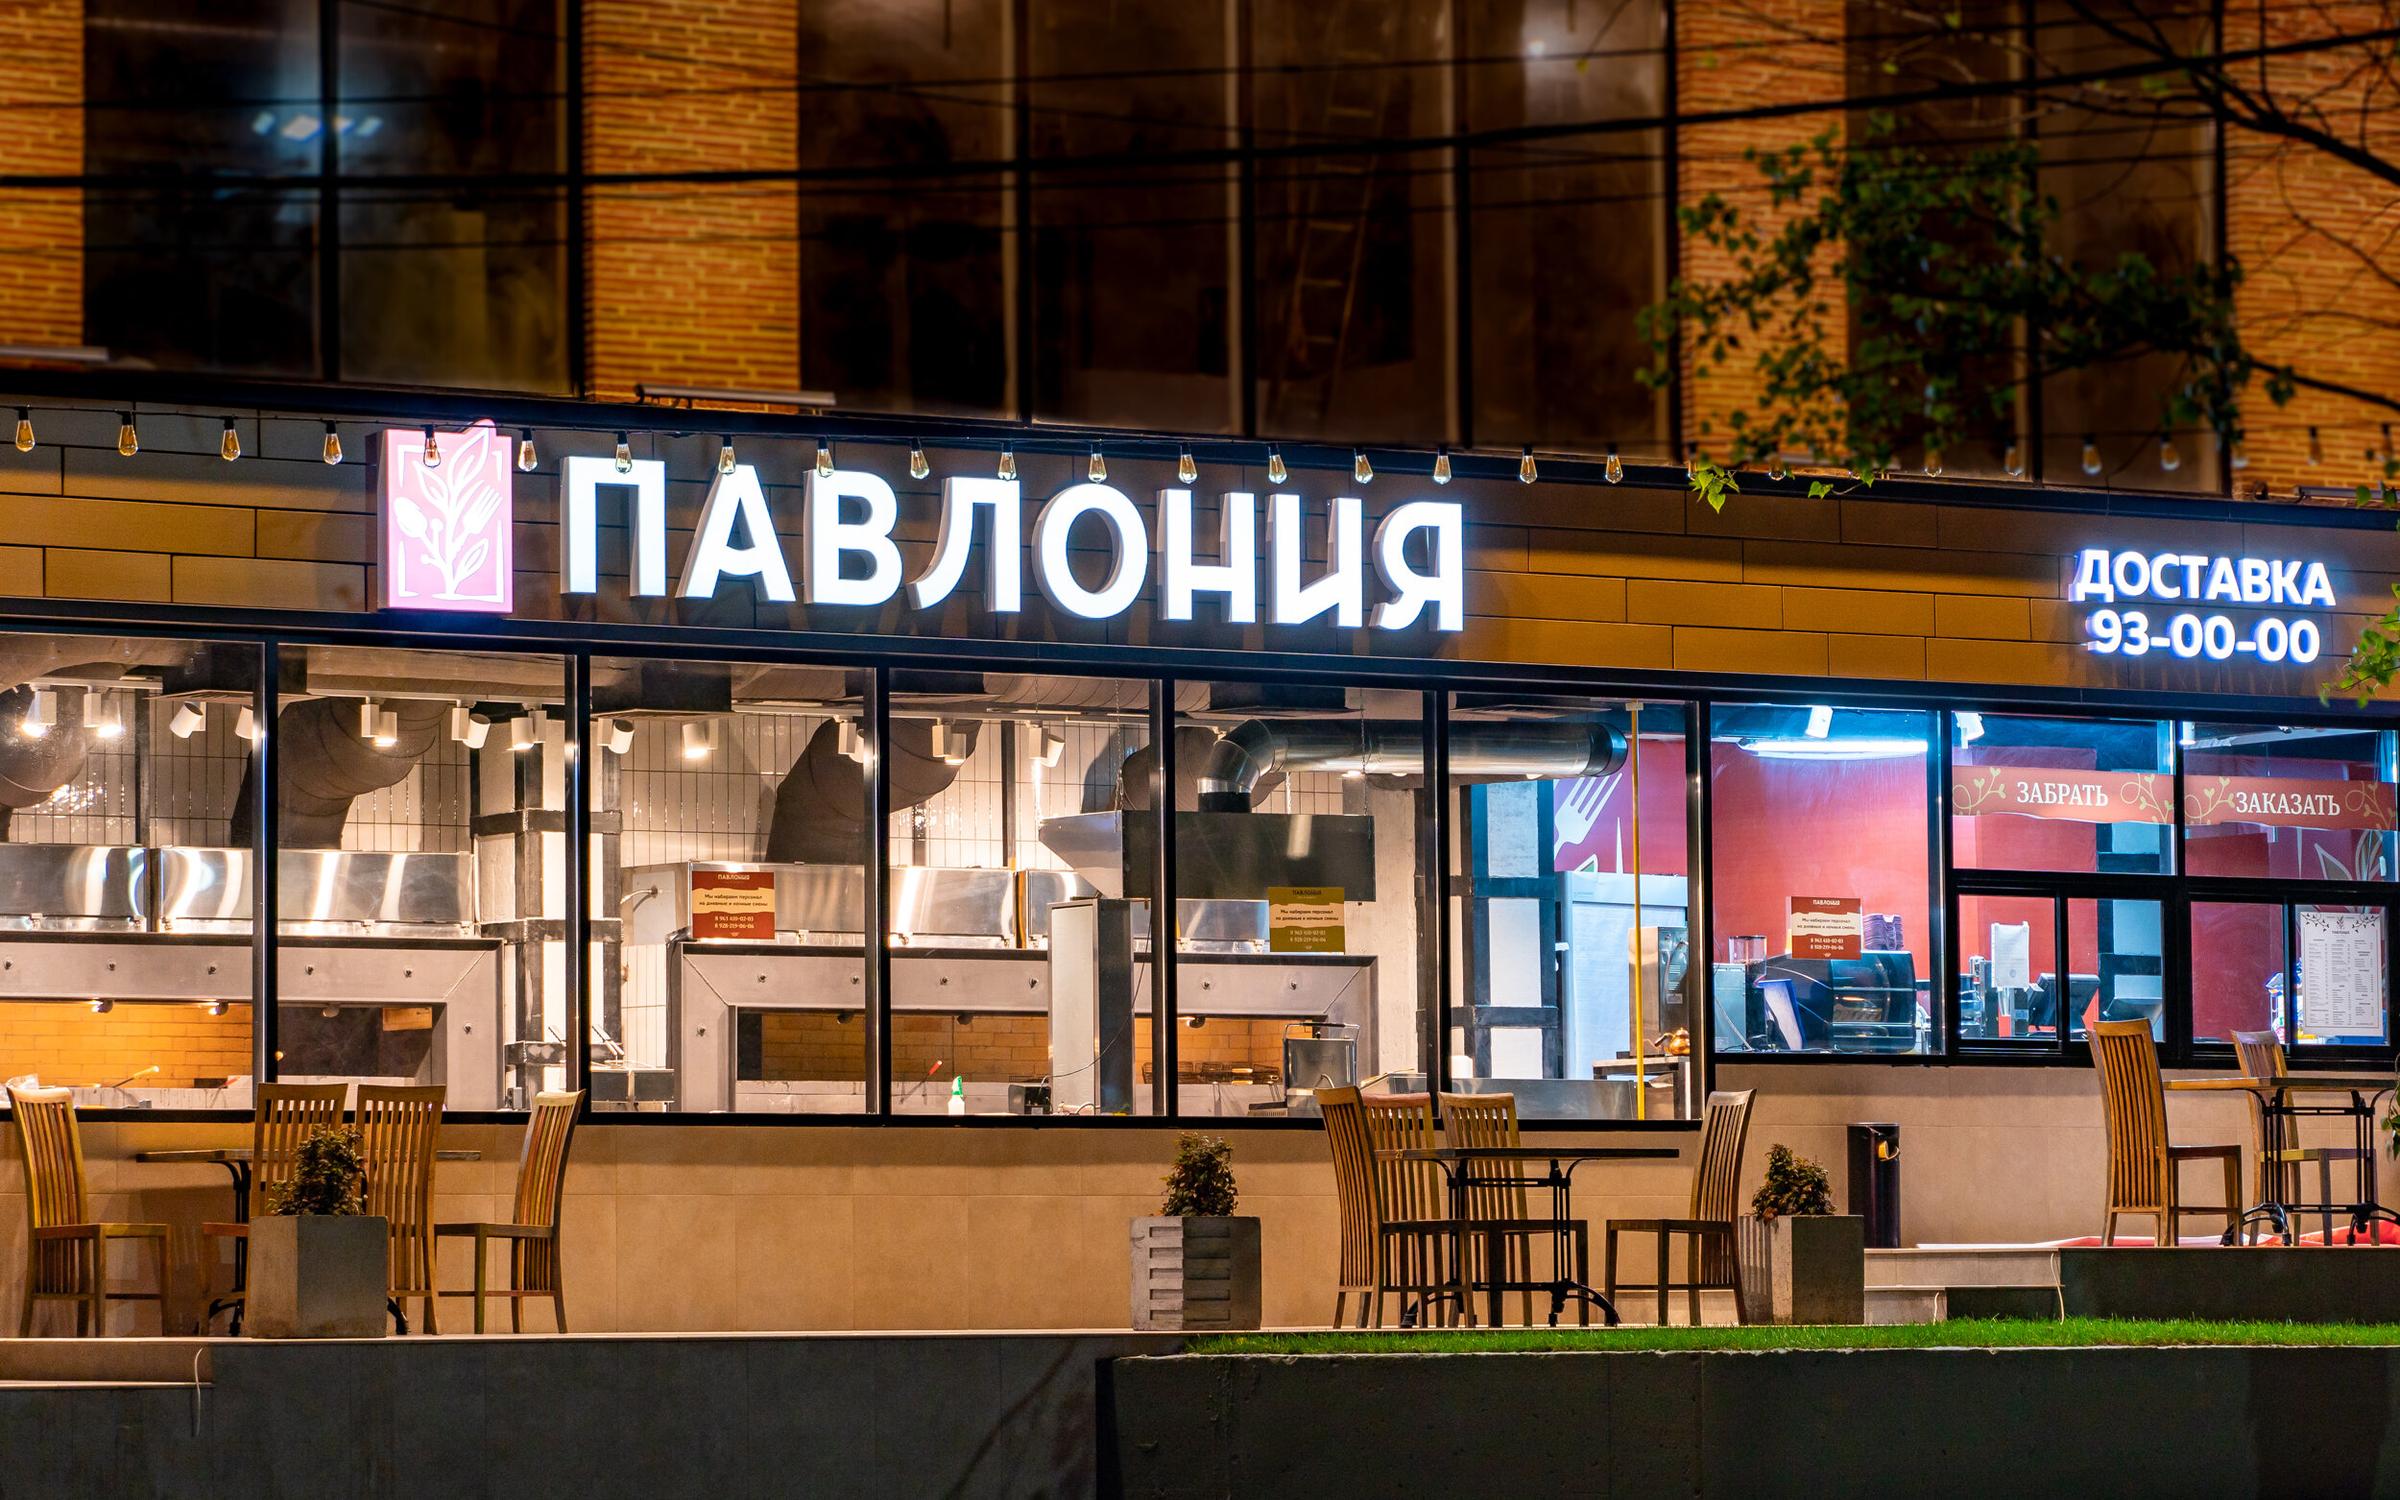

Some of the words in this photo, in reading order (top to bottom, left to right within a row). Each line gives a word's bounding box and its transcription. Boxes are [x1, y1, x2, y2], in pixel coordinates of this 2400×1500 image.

[560, 456, 1465, 633] ПАВЛОНИЯ
[2068, 549, 2336, 606] ДОСТАВКА
[2086, 609, 2321, 664] 93-00-00
[2016, 781, 2109, 807] ЗАБРАТЬ
[2235, 791, 2341, 817] ЗАКАЗАТЬ
